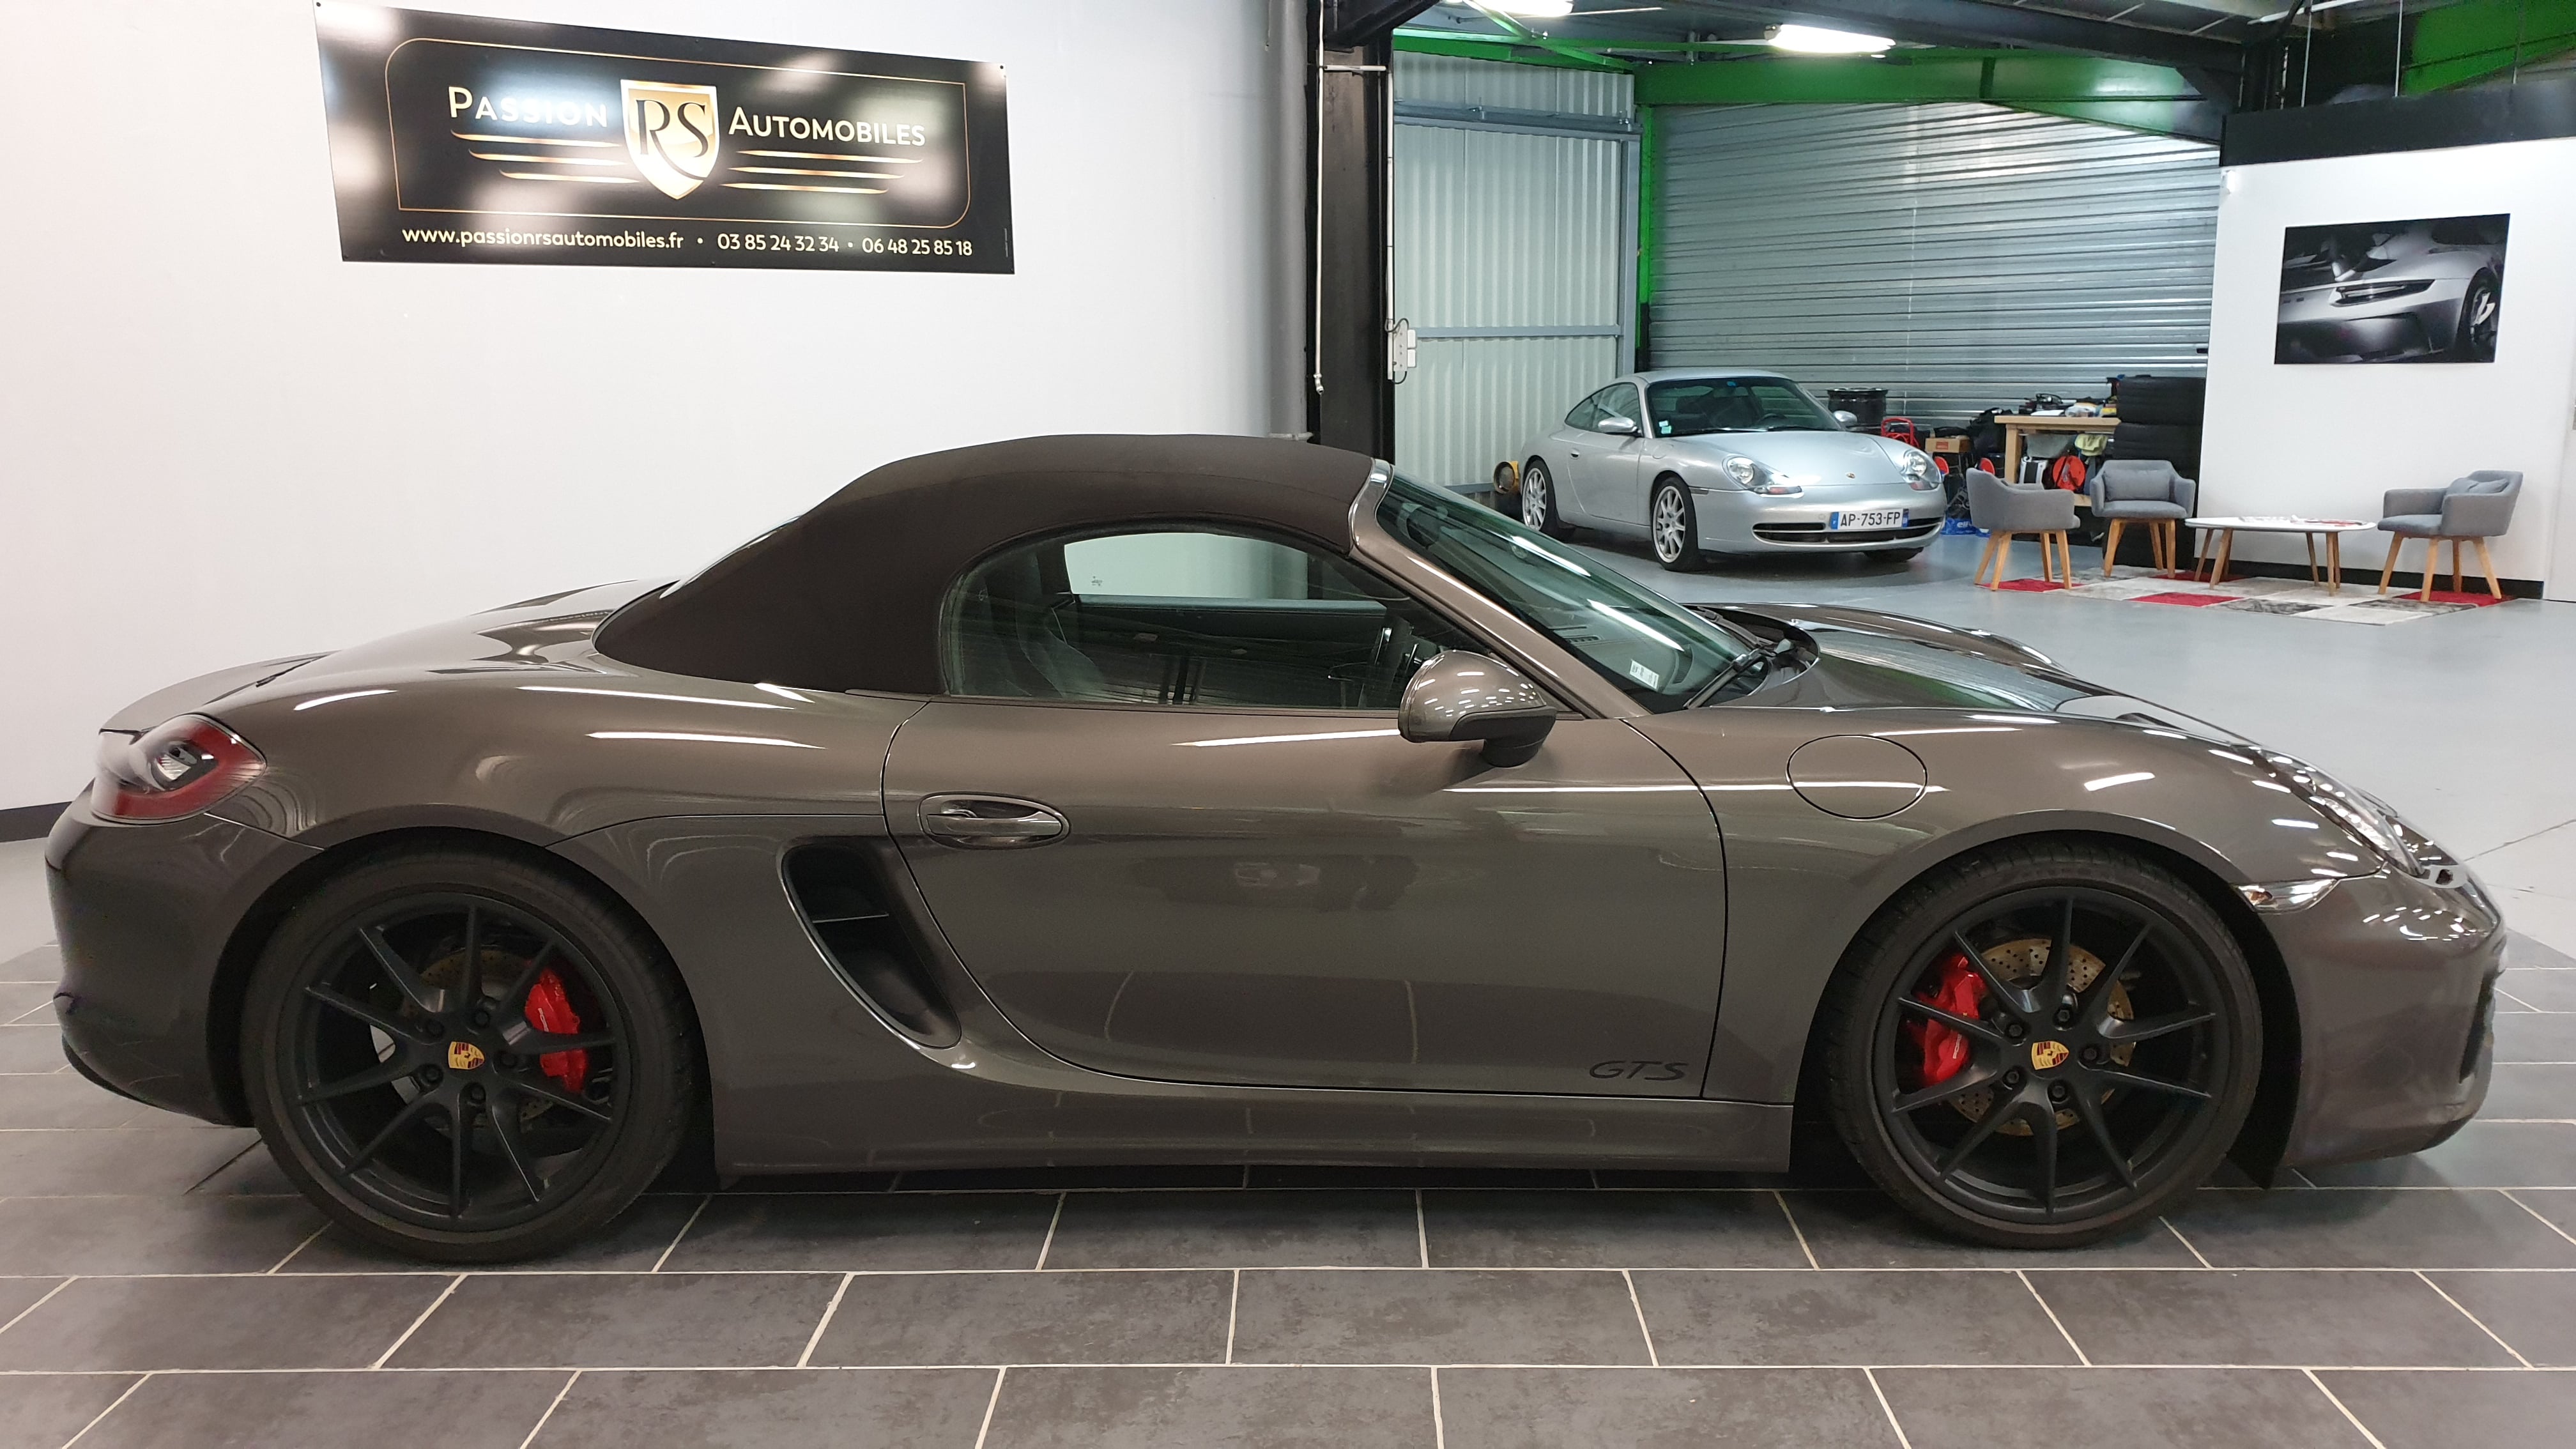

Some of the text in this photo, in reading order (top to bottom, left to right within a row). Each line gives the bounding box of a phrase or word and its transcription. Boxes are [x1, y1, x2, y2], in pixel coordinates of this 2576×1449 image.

[448, 86, 926, 181] PASSION RS AUTOMOBILES
[402, 227, 972, 256] www.passionrsautomobiles.fr 03 85 24 32 34 06 48 25 85 18
[1841, 512, 1901, 526] AP-753-FP
[1589, 1061, 1689, 1081] GTS
